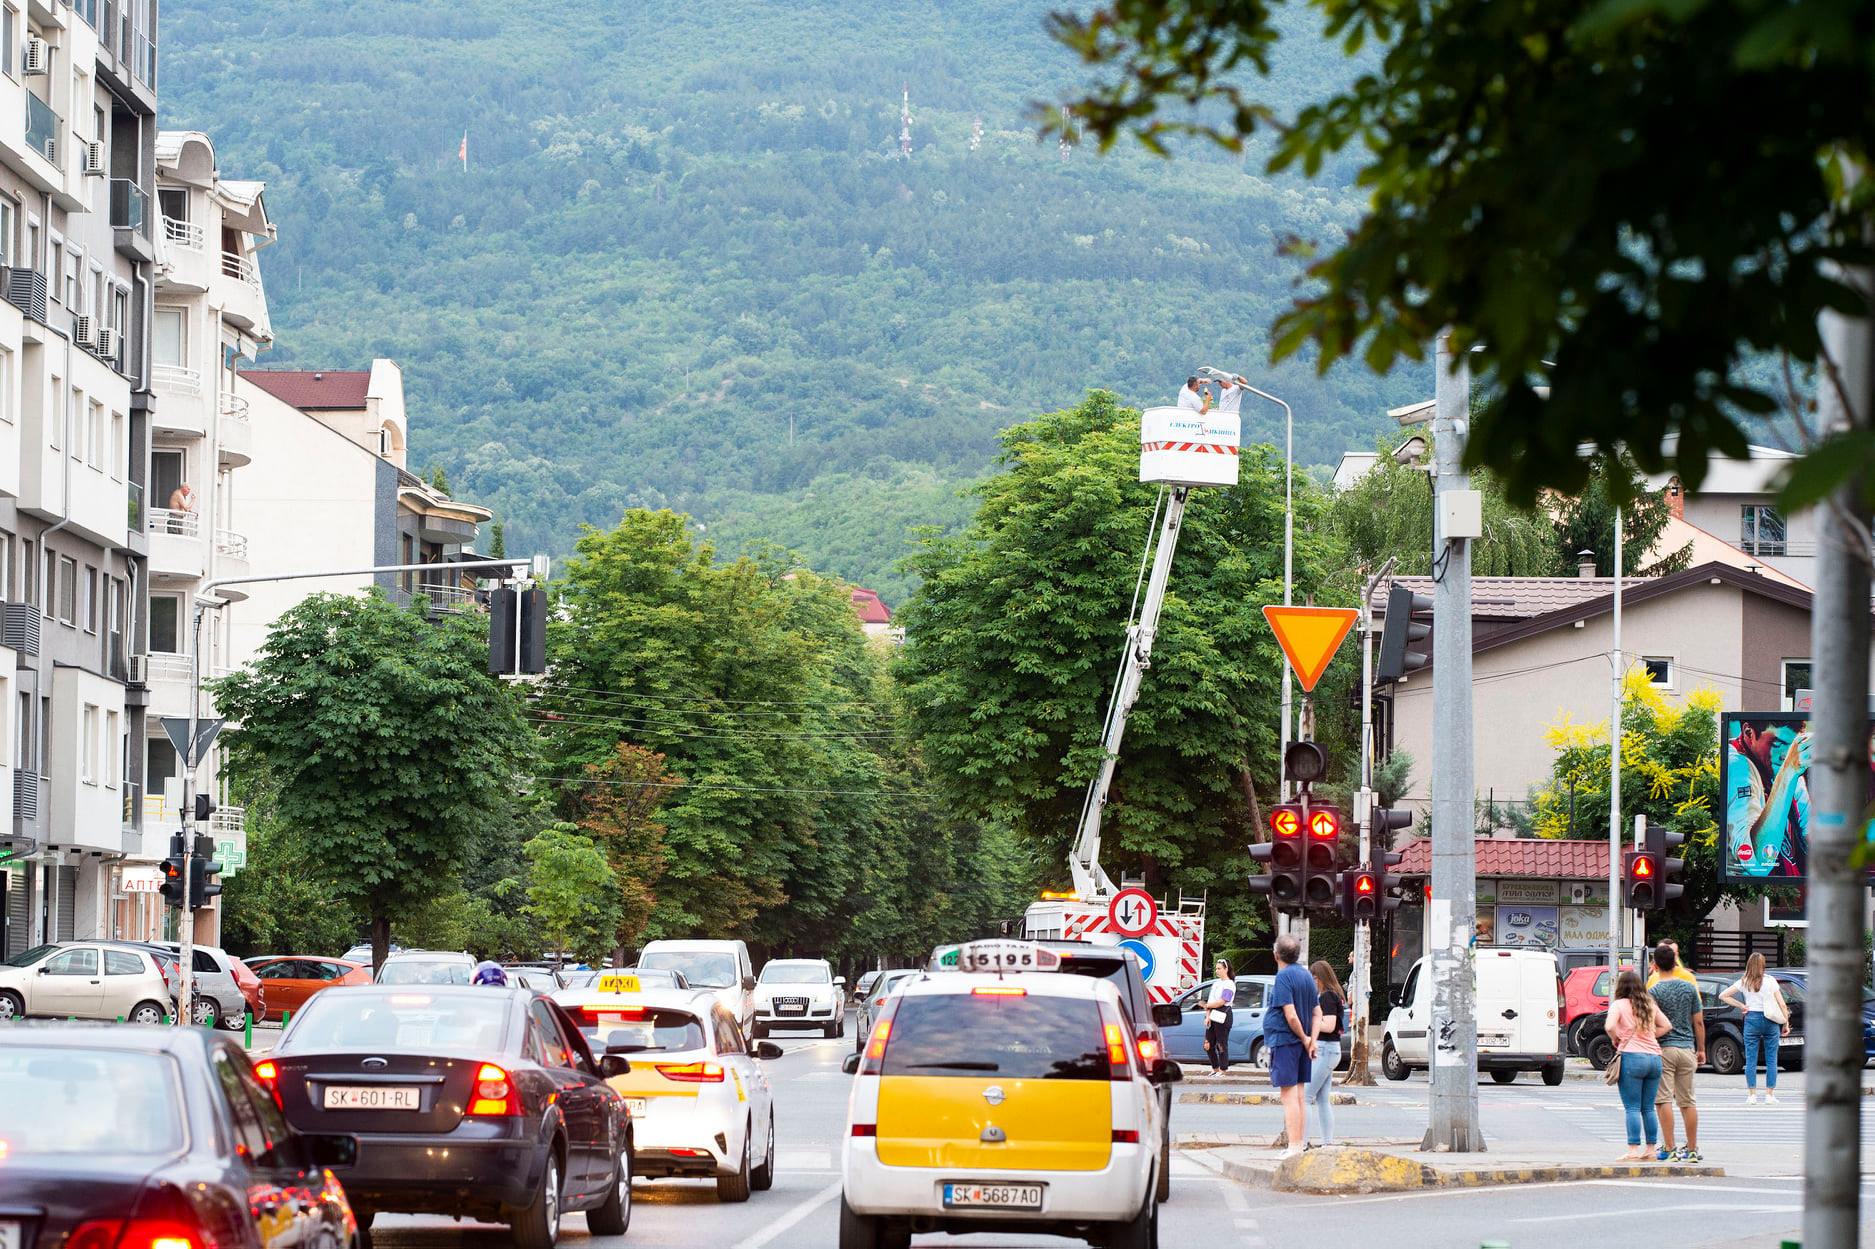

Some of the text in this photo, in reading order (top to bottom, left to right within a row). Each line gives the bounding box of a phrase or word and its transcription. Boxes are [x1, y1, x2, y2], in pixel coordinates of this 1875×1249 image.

[125, 879, 163, 889] АПТЕ
[1585, 930, 1610, 941] ОДМО
[966, 953, 1032, 966] 15195
[604, 979, 633, 988] TAXI
